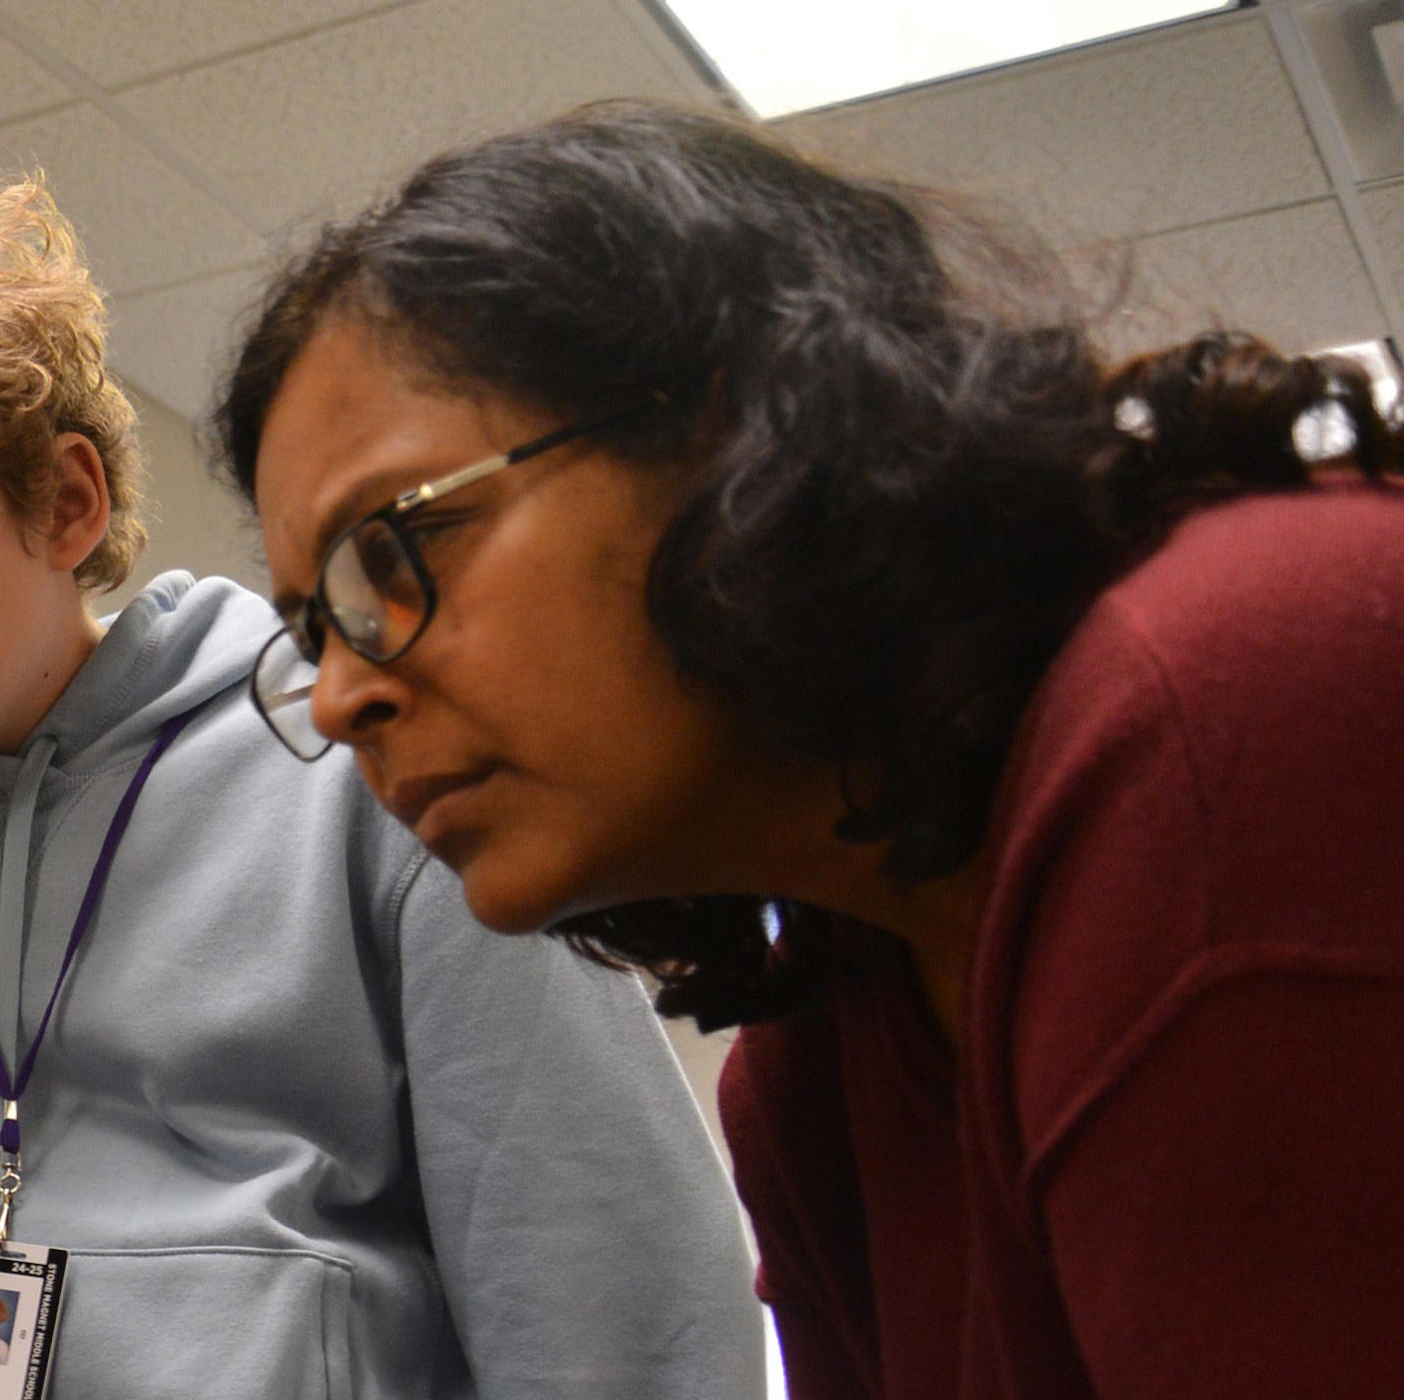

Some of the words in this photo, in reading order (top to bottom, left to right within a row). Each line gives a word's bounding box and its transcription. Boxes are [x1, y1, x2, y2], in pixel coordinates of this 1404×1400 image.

[11, 1262, 44, 1275] 24-25
[44, 1263, 57, 1293] STONE
[38, 1294, 52, 1331] MAGNET
[31, 1332, 46, 1365] MIDDLE
[23, 1366, 40, 1400] SCHOOL
